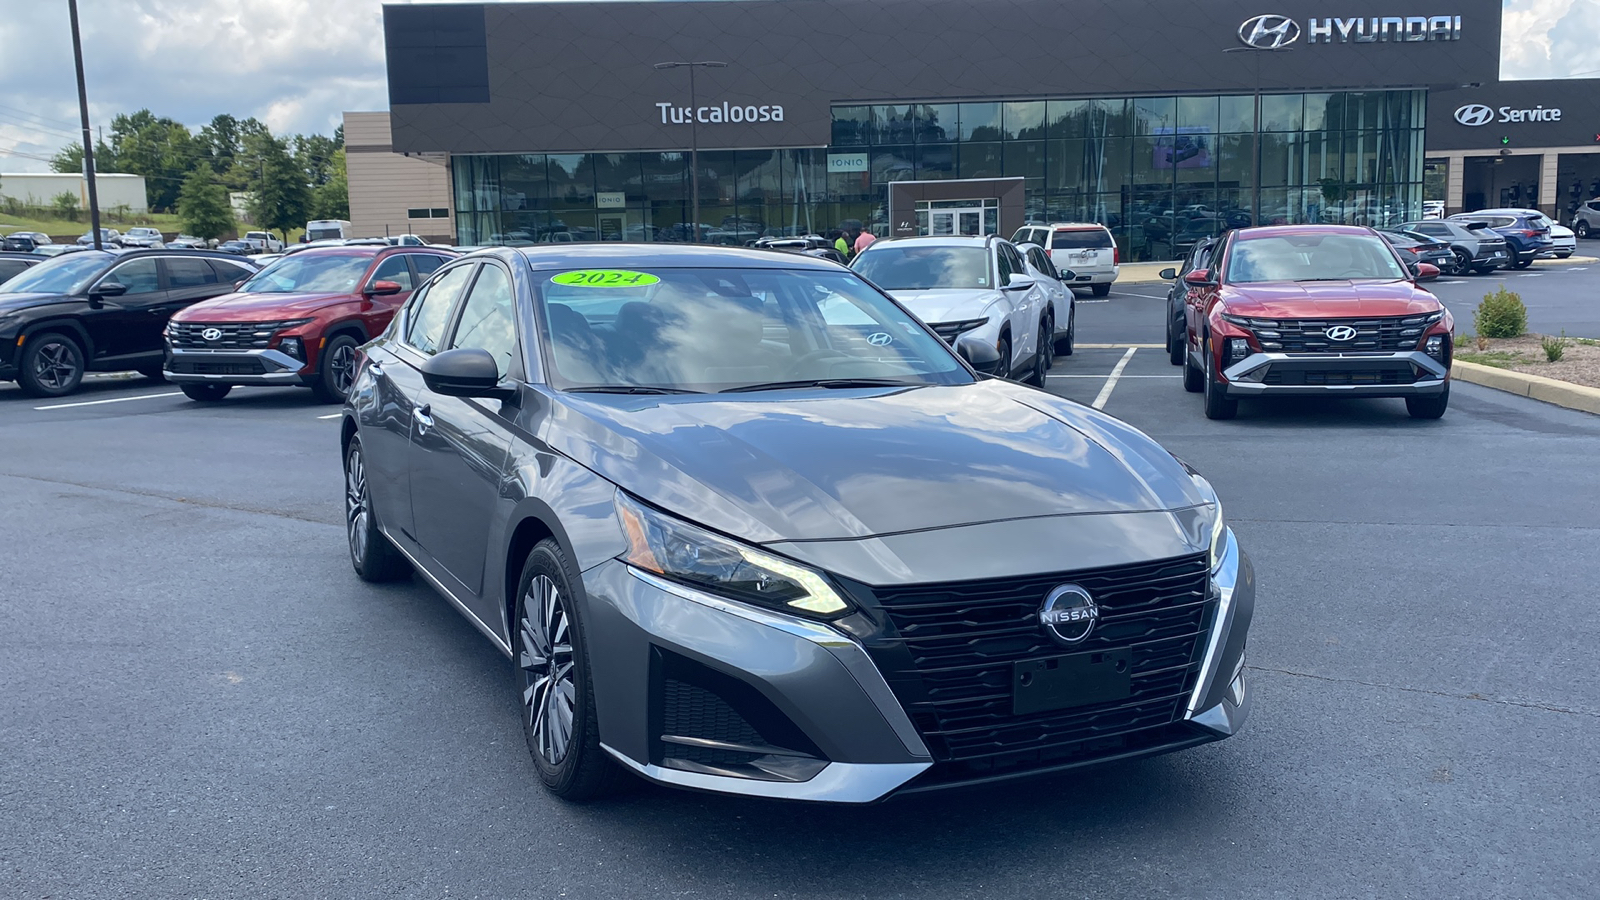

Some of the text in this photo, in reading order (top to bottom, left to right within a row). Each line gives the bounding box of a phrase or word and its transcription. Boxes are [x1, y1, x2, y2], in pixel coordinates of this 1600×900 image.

[1308, 15, 1462, 44] HYUNDAI
[655, 101, 784, 124] Tuscaloosa
[1498, 104, 1562, 123] Service
[568, 272, 643, 284] 2024
[1042, 607, 1098, 623] NISSAN
